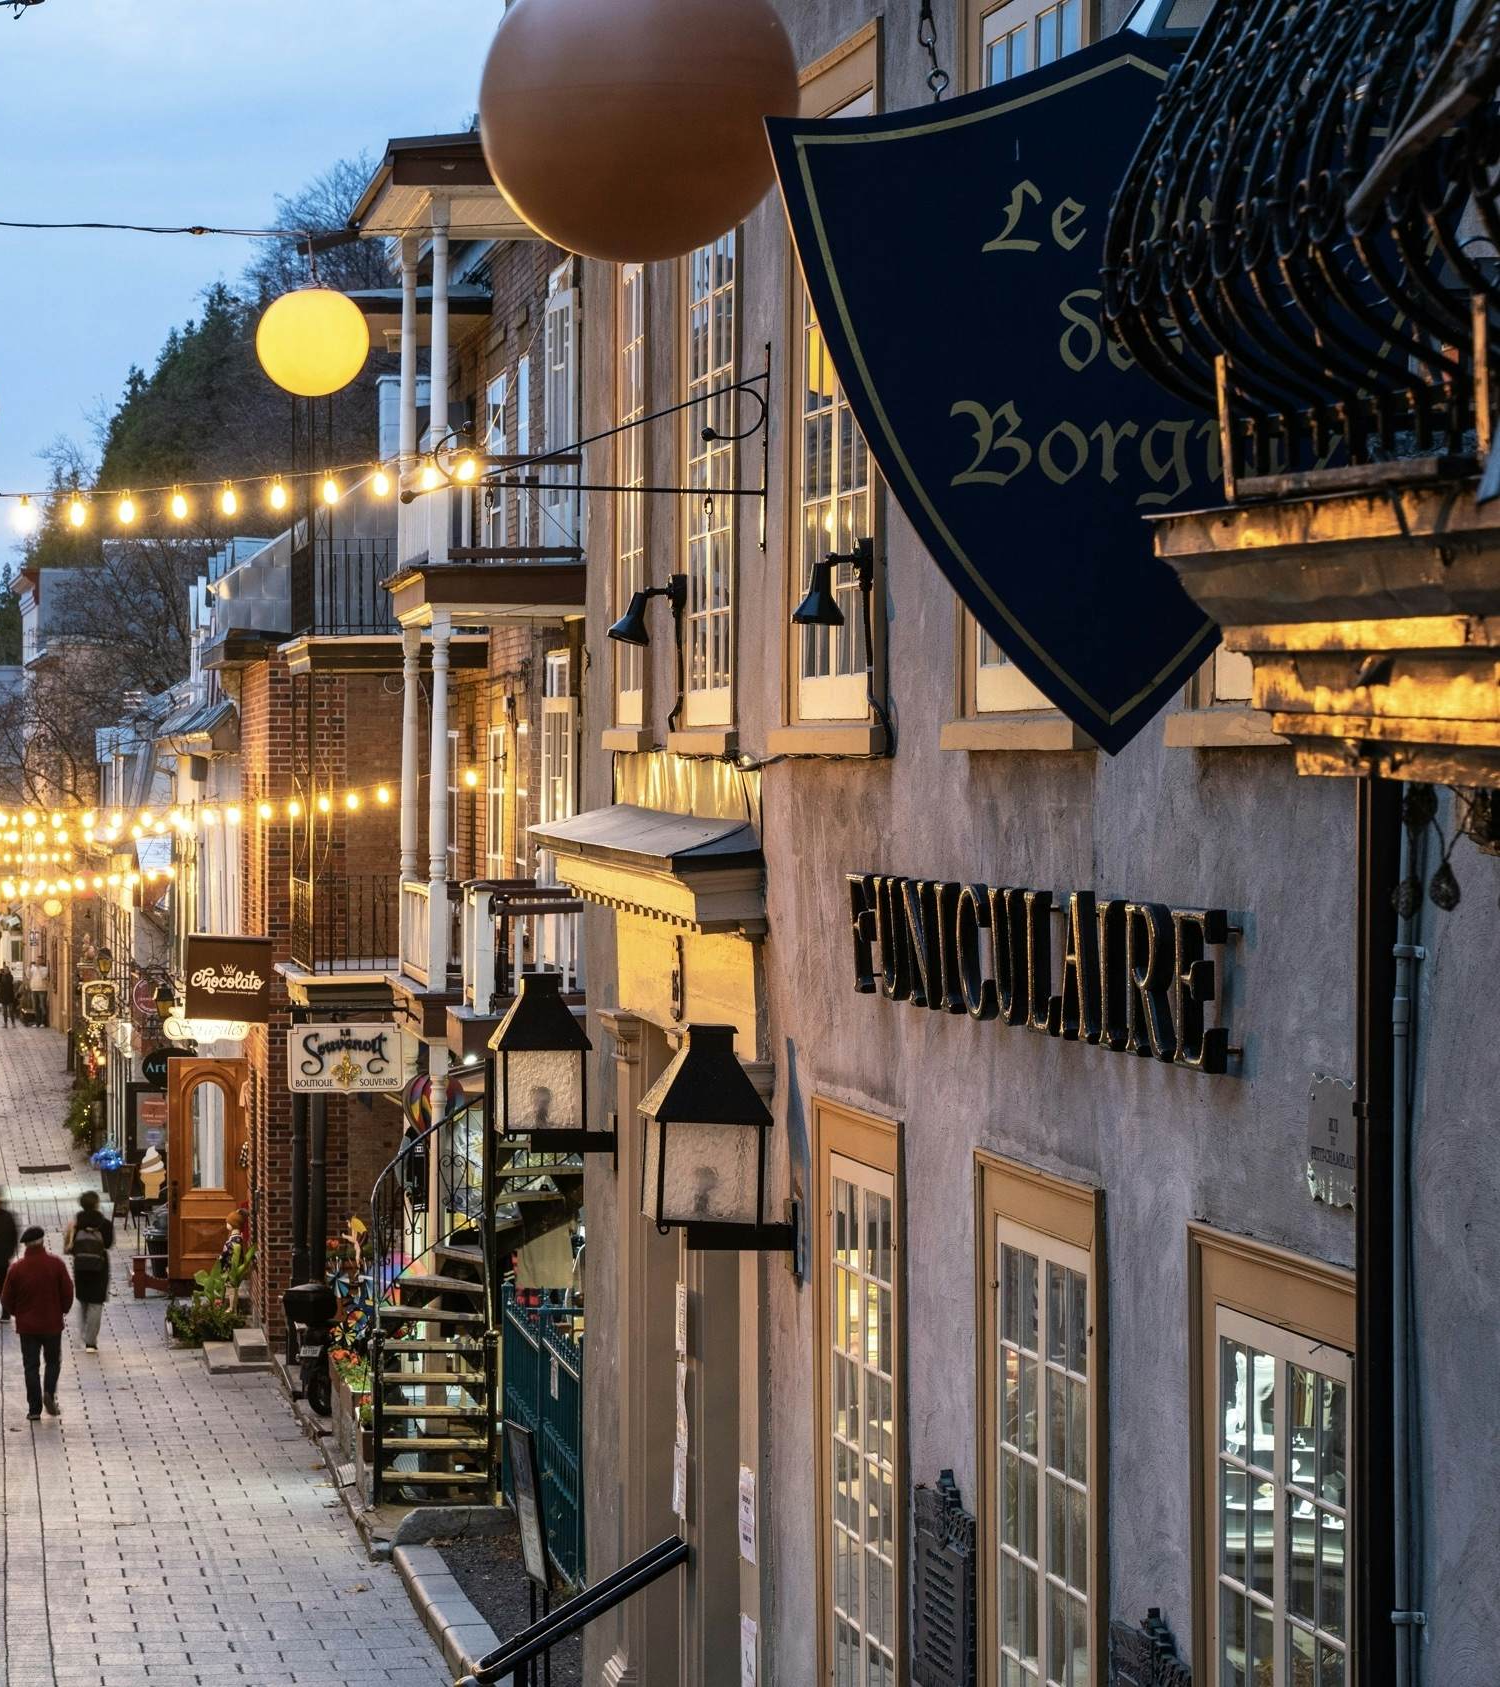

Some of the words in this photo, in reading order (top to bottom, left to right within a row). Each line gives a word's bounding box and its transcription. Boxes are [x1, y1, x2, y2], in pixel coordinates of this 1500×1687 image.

[982, 179, 1088, 252] Le
[191, 967, 265, 994] Chocolato
[845, 872, 1228, 1073] FUNICULAIRE
[295, 1079, 333, 1087] BOUTIQUE
[360, 1078, 398, 1087] SOUVENIRS
